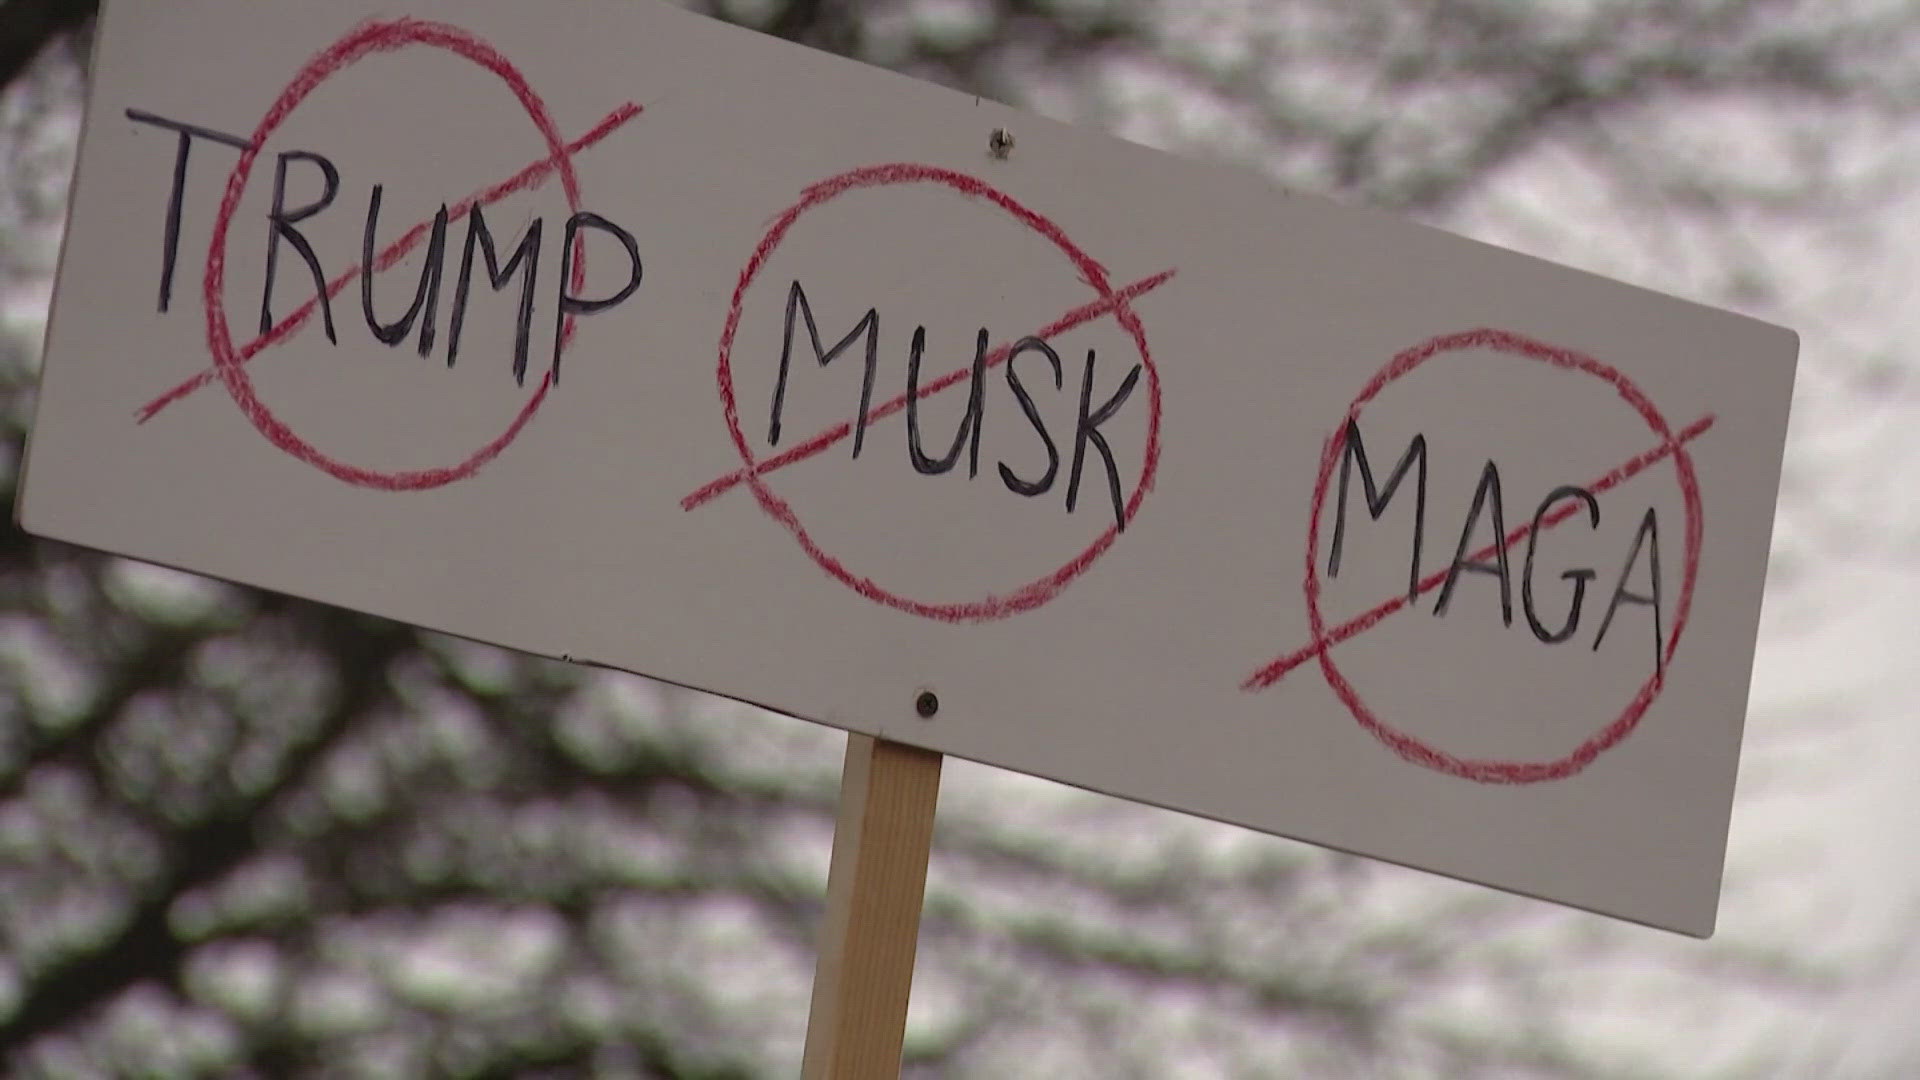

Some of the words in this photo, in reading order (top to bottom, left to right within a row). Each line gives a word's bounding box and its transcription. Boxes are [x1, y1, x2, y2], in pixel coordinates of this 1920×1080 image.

[125, 108, 643, 388] TRUMP
[767, 280, 1142, 534] MUSK
[1327, 416, 1663, 680] MAGA
